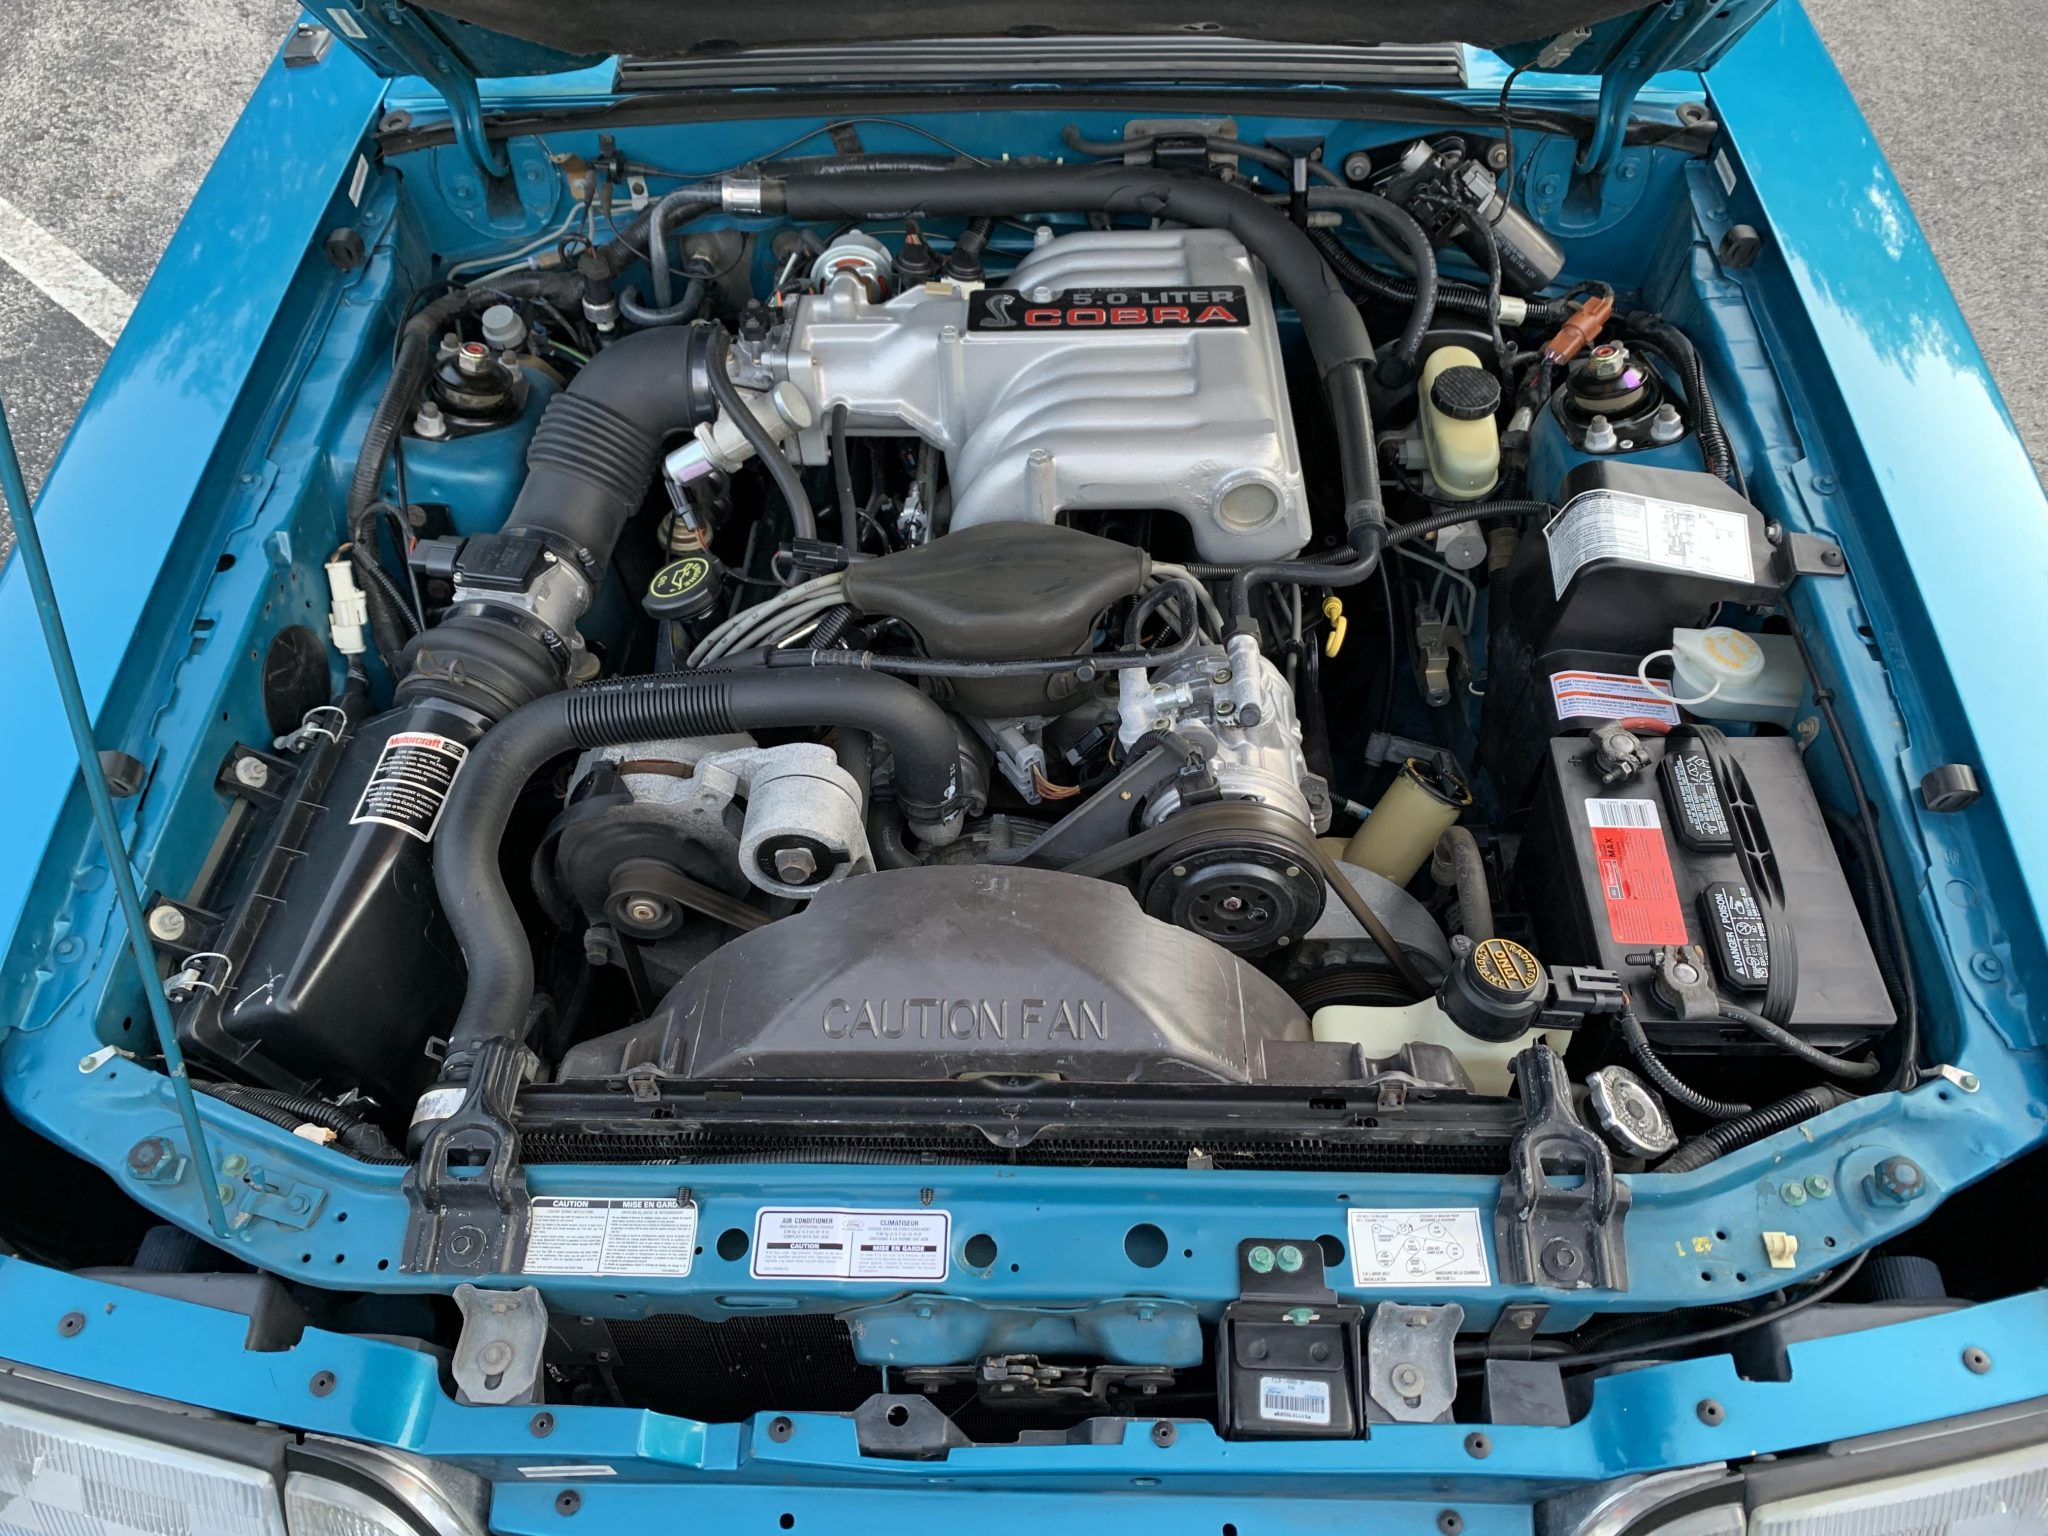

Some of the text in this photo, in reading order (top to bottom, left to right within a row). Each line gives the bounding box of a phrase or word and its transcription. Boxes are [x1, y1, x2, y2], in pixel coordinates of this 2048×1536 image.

[1073, 290, 1235, 305] 5.0 LITER
[1024, 305, 1239, 326] COBRA
[390, 737, 440, 748] Motorcraft
[391, 771, 428, 782] PERFORMANCE
[376, 808, 410, 820] MOTORCRAFT
[1605, 838, 1617, 858] MAX
[1714, 893, 1731, 924] POISON
[1726, 931, 1743, 966] DANGER
[1476, 949, 1505, 986] COOLANT
[1494, 950, 1519, 982] ONLY
[1508, 944, 1538, 984] RADIATOR
[821, 997, 1109, 1041] CAUTION FAN
[552, 1199, 589, 1208] CAUTION
[622, 1200, 679, 1209] MISE EN GARD
[880, 1219, 919, 1227] CLIMATISEUR
